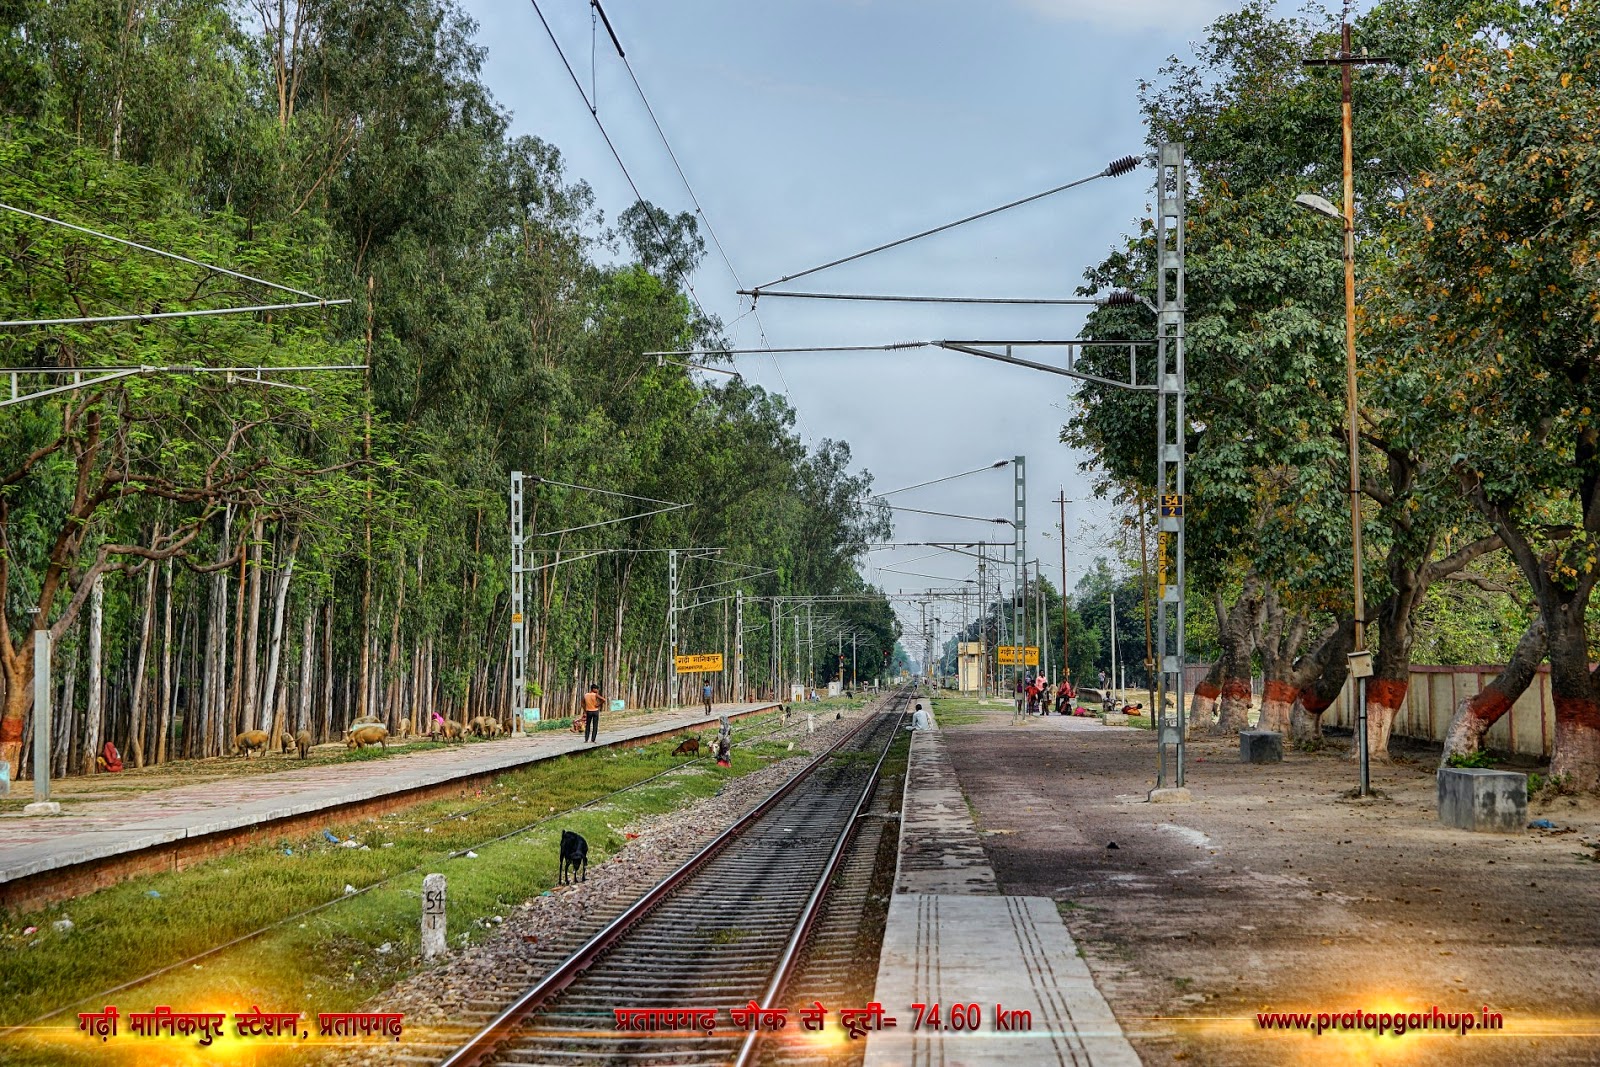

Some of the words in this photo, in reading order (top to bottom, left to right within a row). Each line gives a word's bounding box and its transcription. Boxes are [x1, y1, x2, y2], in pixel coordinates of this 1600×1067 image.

[1164, 496, 1179, 505] 54
[1168, 507, 1176, 516] 2
[426, 890, 444, 910] 54
[432, 915, 436, 930] 1
